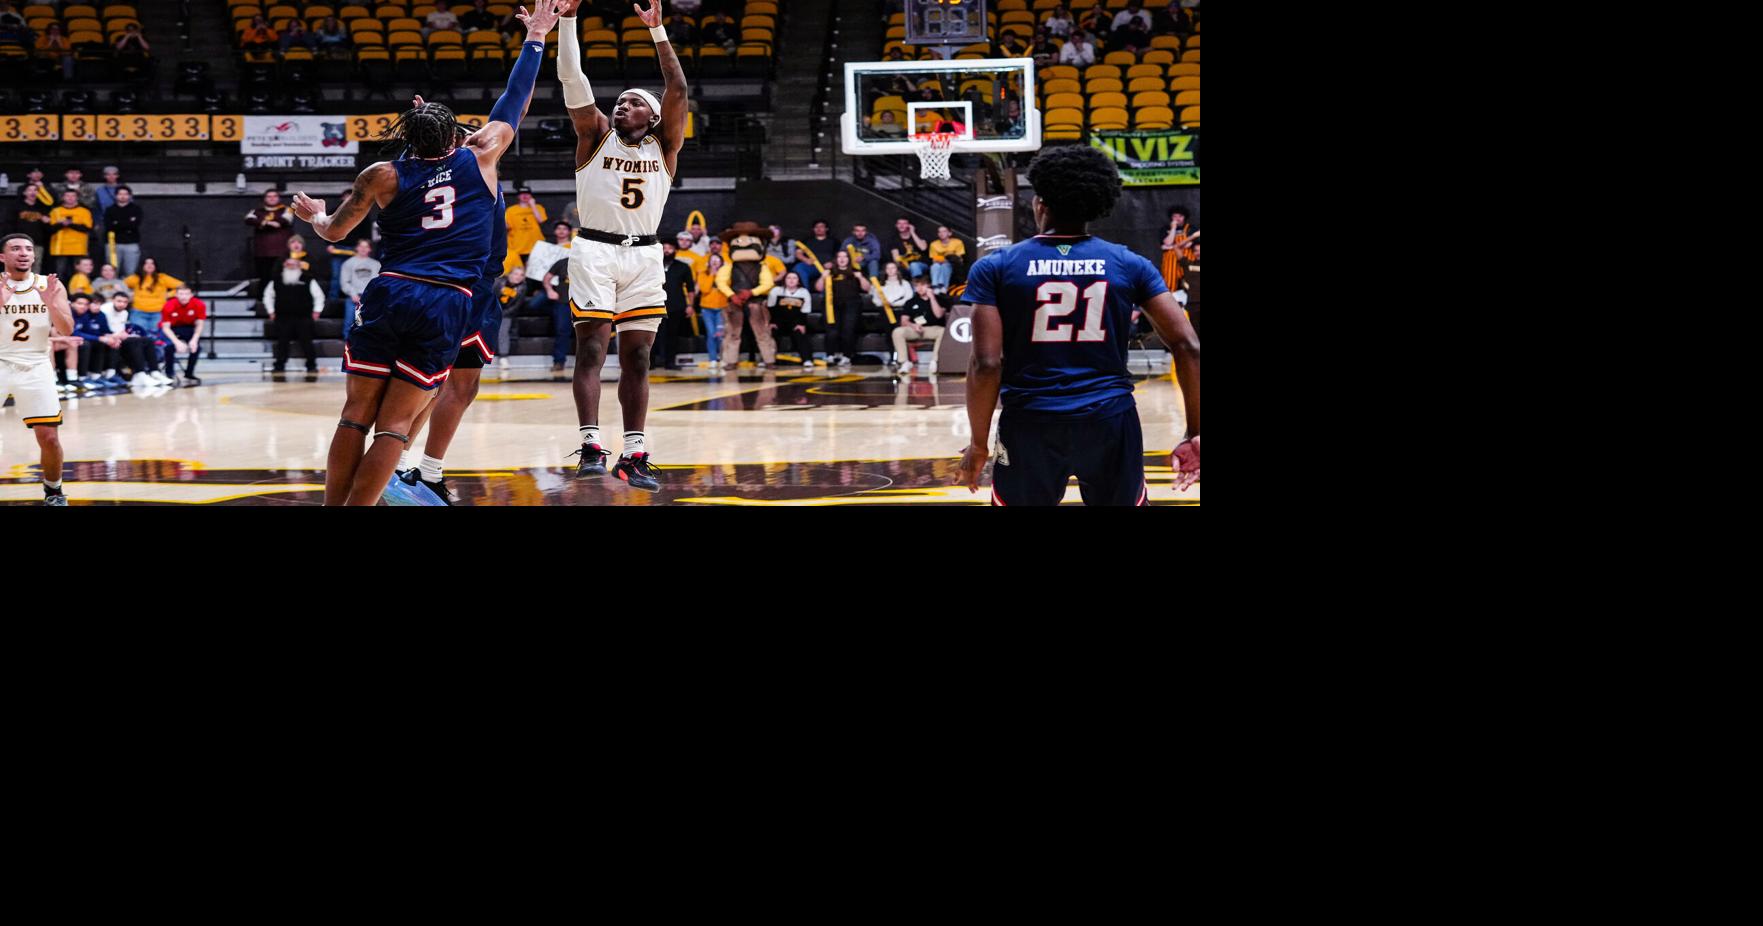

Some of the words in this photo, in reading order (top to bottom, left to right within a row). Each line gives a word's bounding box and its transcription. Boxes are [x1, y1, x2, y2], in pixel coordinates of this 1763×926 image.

[221, 118, 236, 138] 3
[354, 118, 368, 138] 3
[1131, 135, 1193, 161] VIZ
[245, 156, 254, 168] 3
[257, 156, 295, 168] POINT
[298, 156, 356, 168] TRACKER
[603, 156, 659, 173] WYOMING
[421, 169, 452, 189] RICE
[620, 177, 646, 211] 5
[421, 185, 456, 230] 3
[1026, 259, 1106, 276] AMUNEKE
[0, 304, 47, 314] YOMING
[1031, 281, 1108, 342] 21
[12, 318, 30, 342] 2
